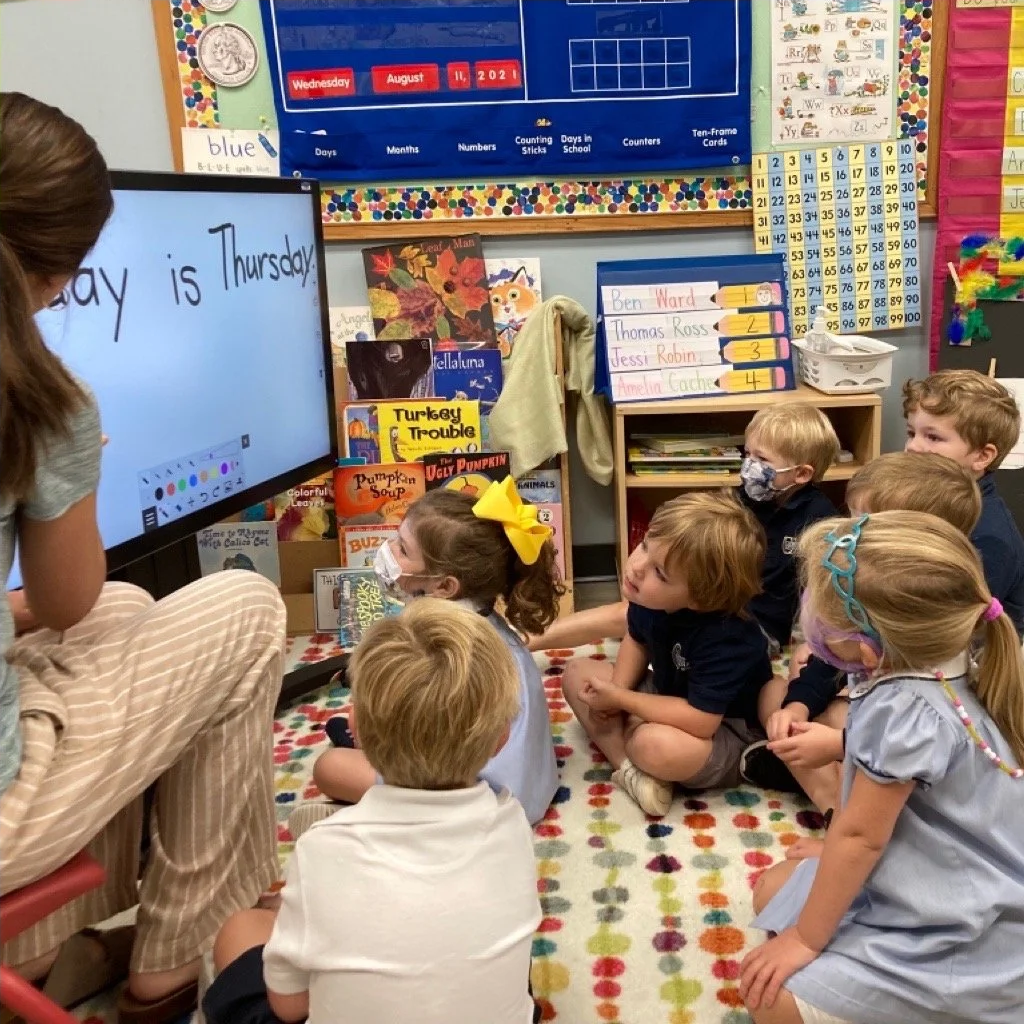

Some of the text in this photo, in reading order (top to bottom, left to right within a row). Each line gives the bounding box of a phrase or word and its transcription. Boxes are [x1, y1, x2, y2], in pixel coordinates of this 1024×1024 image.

[292, 77, 350, 91] Wednesday
[386, 72, 424, 85] August
[515, 135, 553, 146] Counting
[560, 134, 593, 145] Days in
[622, 136, 661, 147] Counters
[692, 127, 738, 137] Ten-Frame
[702, 137, 728, 147] Cards
[207, 135, 255, 158] blue
[315, 147, 337, 159] Days
[386, 145, 420, 155] Months
[458, 142, 497, 153] Numbers
[521, 146, 547, 155] Sticks
[563, 144, 591, 154] School
[758, 143, 912, 169] 1 2 3 4 5 6 7 8 9 10
[756, 162, 914, 189] 11 12 13 14 15 16 17 18 19 20
[756, 181, 915, 209] 21 22 23 24 25 26 27 28 29 30
[757, 201, 916, 227] 31 32 33 34 35 36 37 38 39 40
[758, 219, 917, 246] 41 42 43 44 45 46 47 48 49 50
[452, 238, 475, 250] Man
[791, 250, 804, 261] 53
[807, 249, 820, 259] 54
[823, 247, 836, 258] 55
[839, 245, 852, 256] 56
[855, 243, 868, 255] 57
[871, 242, 884, 252] 58
[887, 240, 901, 251] 59
[903, 238, 917, 249] 60
[792, 269, 805, 280] 63
[807, 267, 821, 278] 64
[824, 265, 837, 276] 65
[839, 264, 853, 275] 66
[856, 262, 869, 272] 67
[872, 260, 885, 271] 68
[888, 258, 901, 269] 69
[904, 257, 917, 268] 70
[793, 276, 918, 298] 73 74 75 76 77 78 79 80
[72, 267, 128, 343] ay
[166, 253, 202, 307] is
[611, 287, 748, 311] Ben Ward 1
[794, 305, 806, 316] 83
[842, 300, 854, 311] 86
[858, 299, 870, 310] 87
[874, 296, 886, 308] 88
[890, 295, 902, 306] 89
[905, 294, 919, 304] 90
[610, 318, 665, 341] Thomas
[746, 316, 759, 334] 2
[794, 324, 807, 335] 93
[826, 320, 839, 331] 95
[842, 318, 855, 329] 96
[858, 316, 871, 328] 97
[874, 315, 887, 326] 98
[890, 313, 903, 324] 99
[904, 312, 921, 323] 100
[434, 352, 485, 370] tellaluna
[611, 341, 761, 368] Jessi Robin 3
[618, 375, 662, 396] Amelia
[746, 371, 760, 390] 4
[393, 406, 461, 424] Turkey
[408, 423, 476, 440] Trouble
[426, 454, 506, 481] UGLY PUMPKIN
[353, 469, 416, 490] Pumpkin
[288, 487, 327, 497] Colorful
